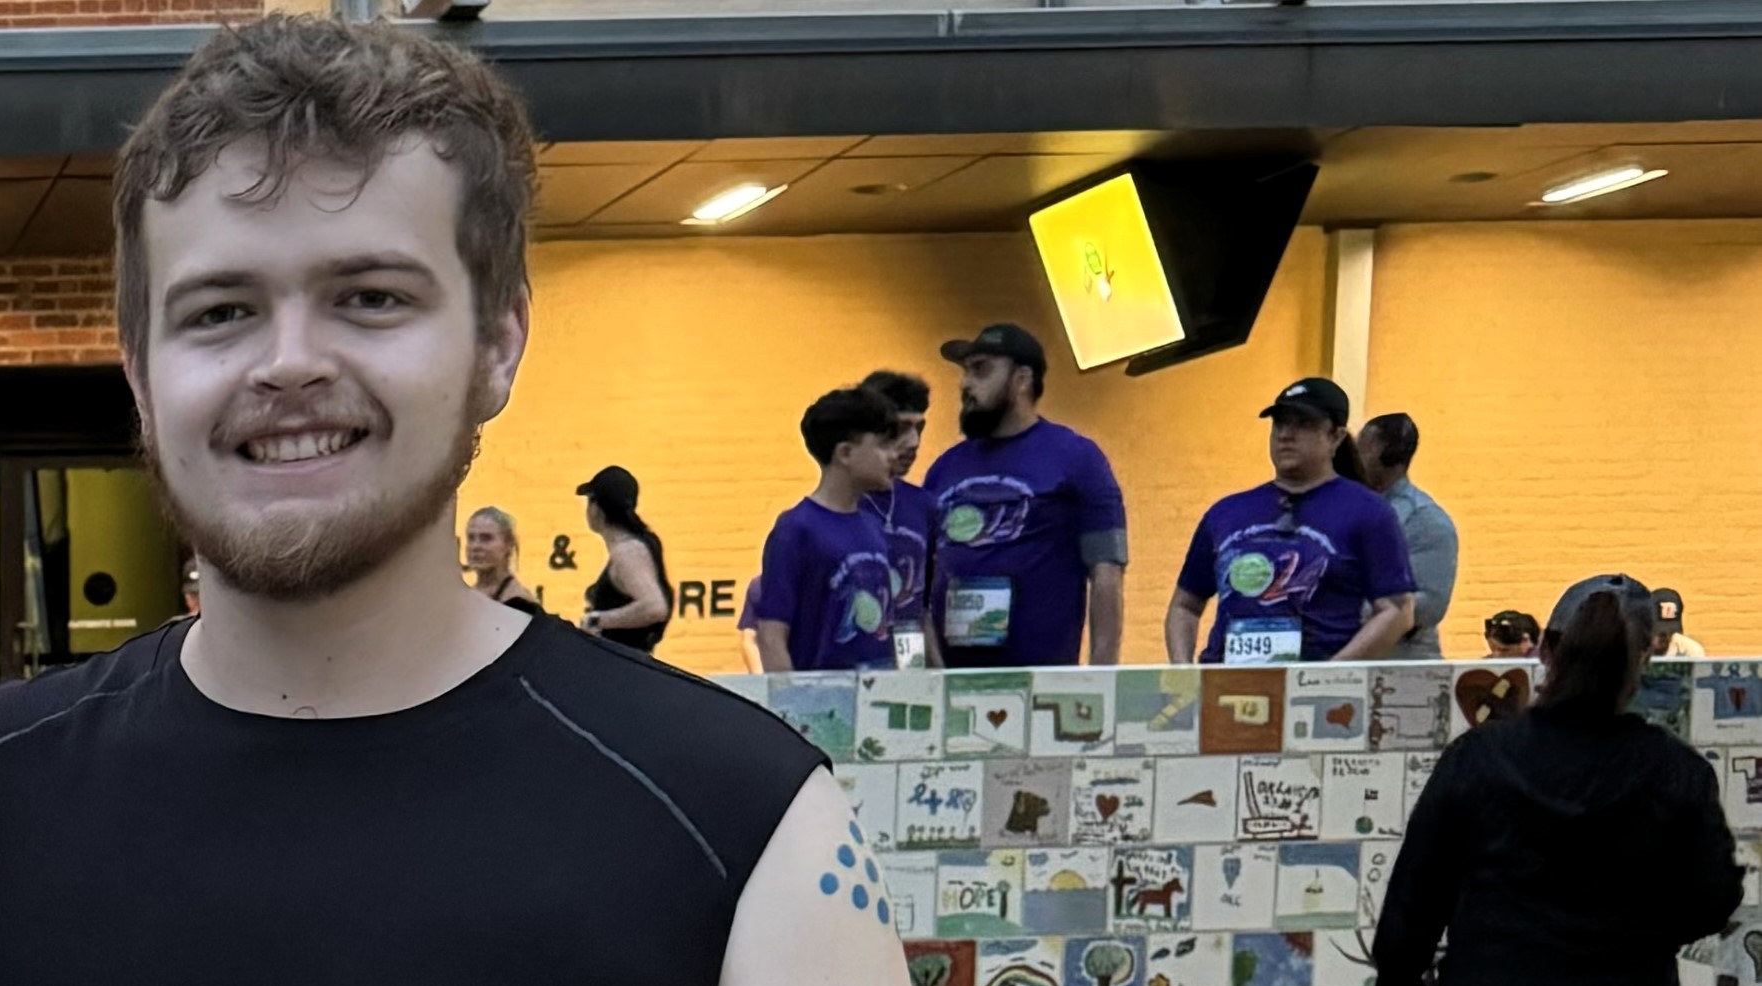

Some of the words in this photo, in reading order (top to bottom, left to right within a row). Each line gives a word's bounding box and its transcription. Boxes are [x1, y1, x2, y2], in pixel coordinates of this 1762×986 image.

[548, 535, 578, 571] &
[678, 580, 736, 618] RE
[1229, 636, 1272, 655] 43949
